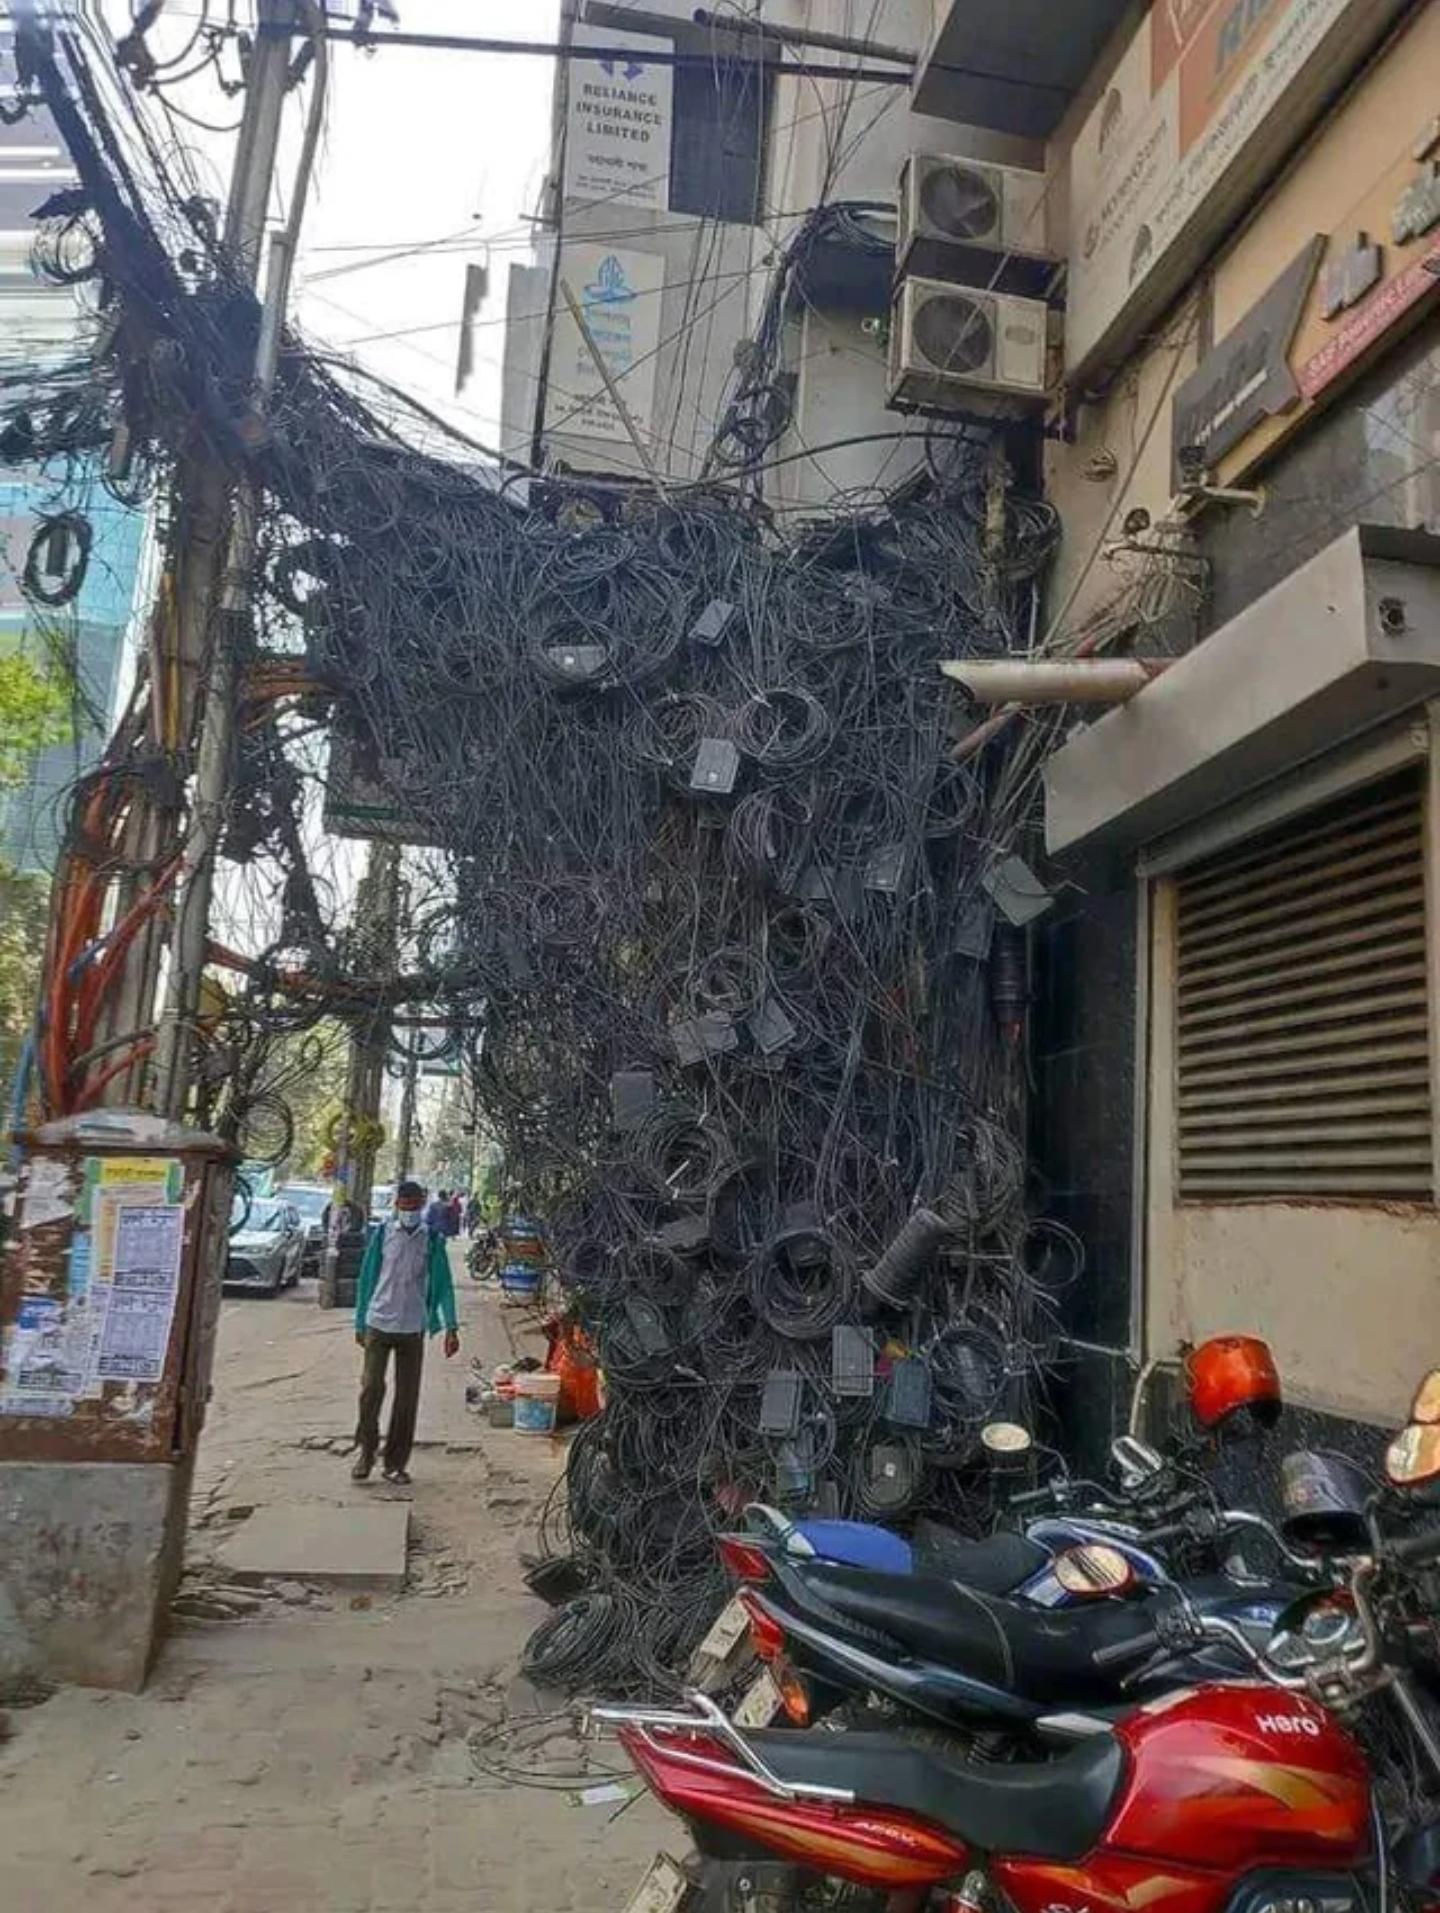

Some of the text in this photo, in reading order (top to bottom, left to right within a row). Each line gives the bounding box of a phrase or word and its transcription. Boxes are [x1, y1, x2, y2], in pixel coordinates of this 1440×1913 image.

[583, 83, 657, 106] RELIANCE
[576, 101, 662, 126] INSURANCE
[587, 121, 650, 143] LIMITED
[1255, 1714, 1319, 1736] Hero
